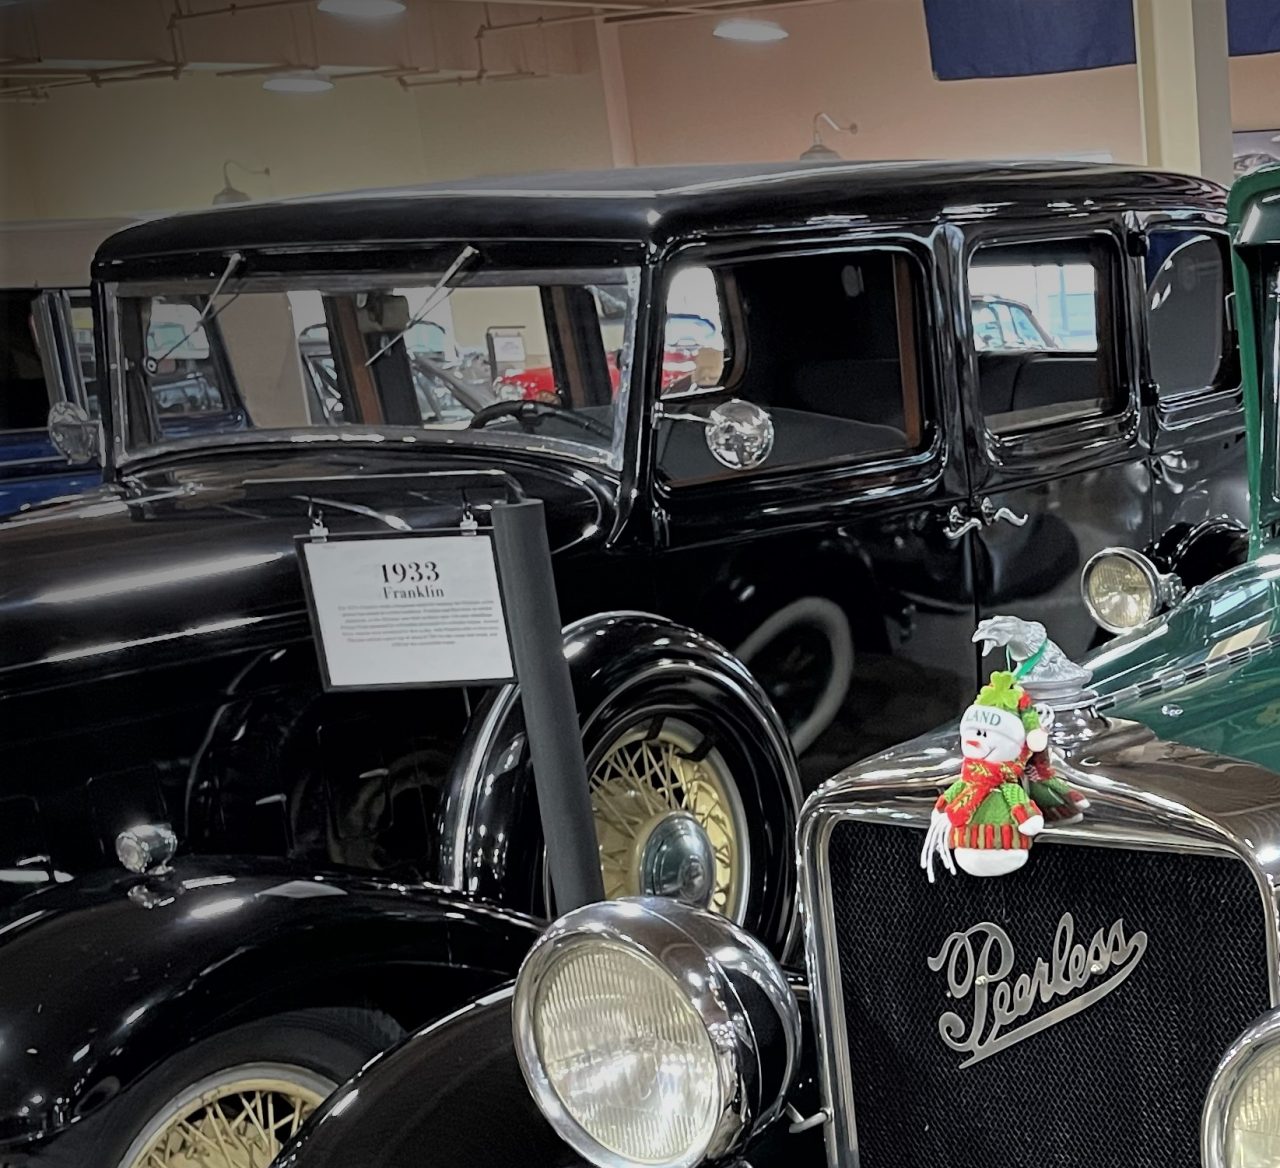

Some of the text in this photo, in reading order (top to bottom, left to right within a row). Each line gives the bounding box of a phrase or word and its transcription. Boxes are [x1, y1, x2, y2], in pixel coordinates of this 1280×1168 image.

[381, 561, 440, 584] 1933
[383, 585, 445, 600] Franklin
[928, 912, 1148, 1069] Peerless
